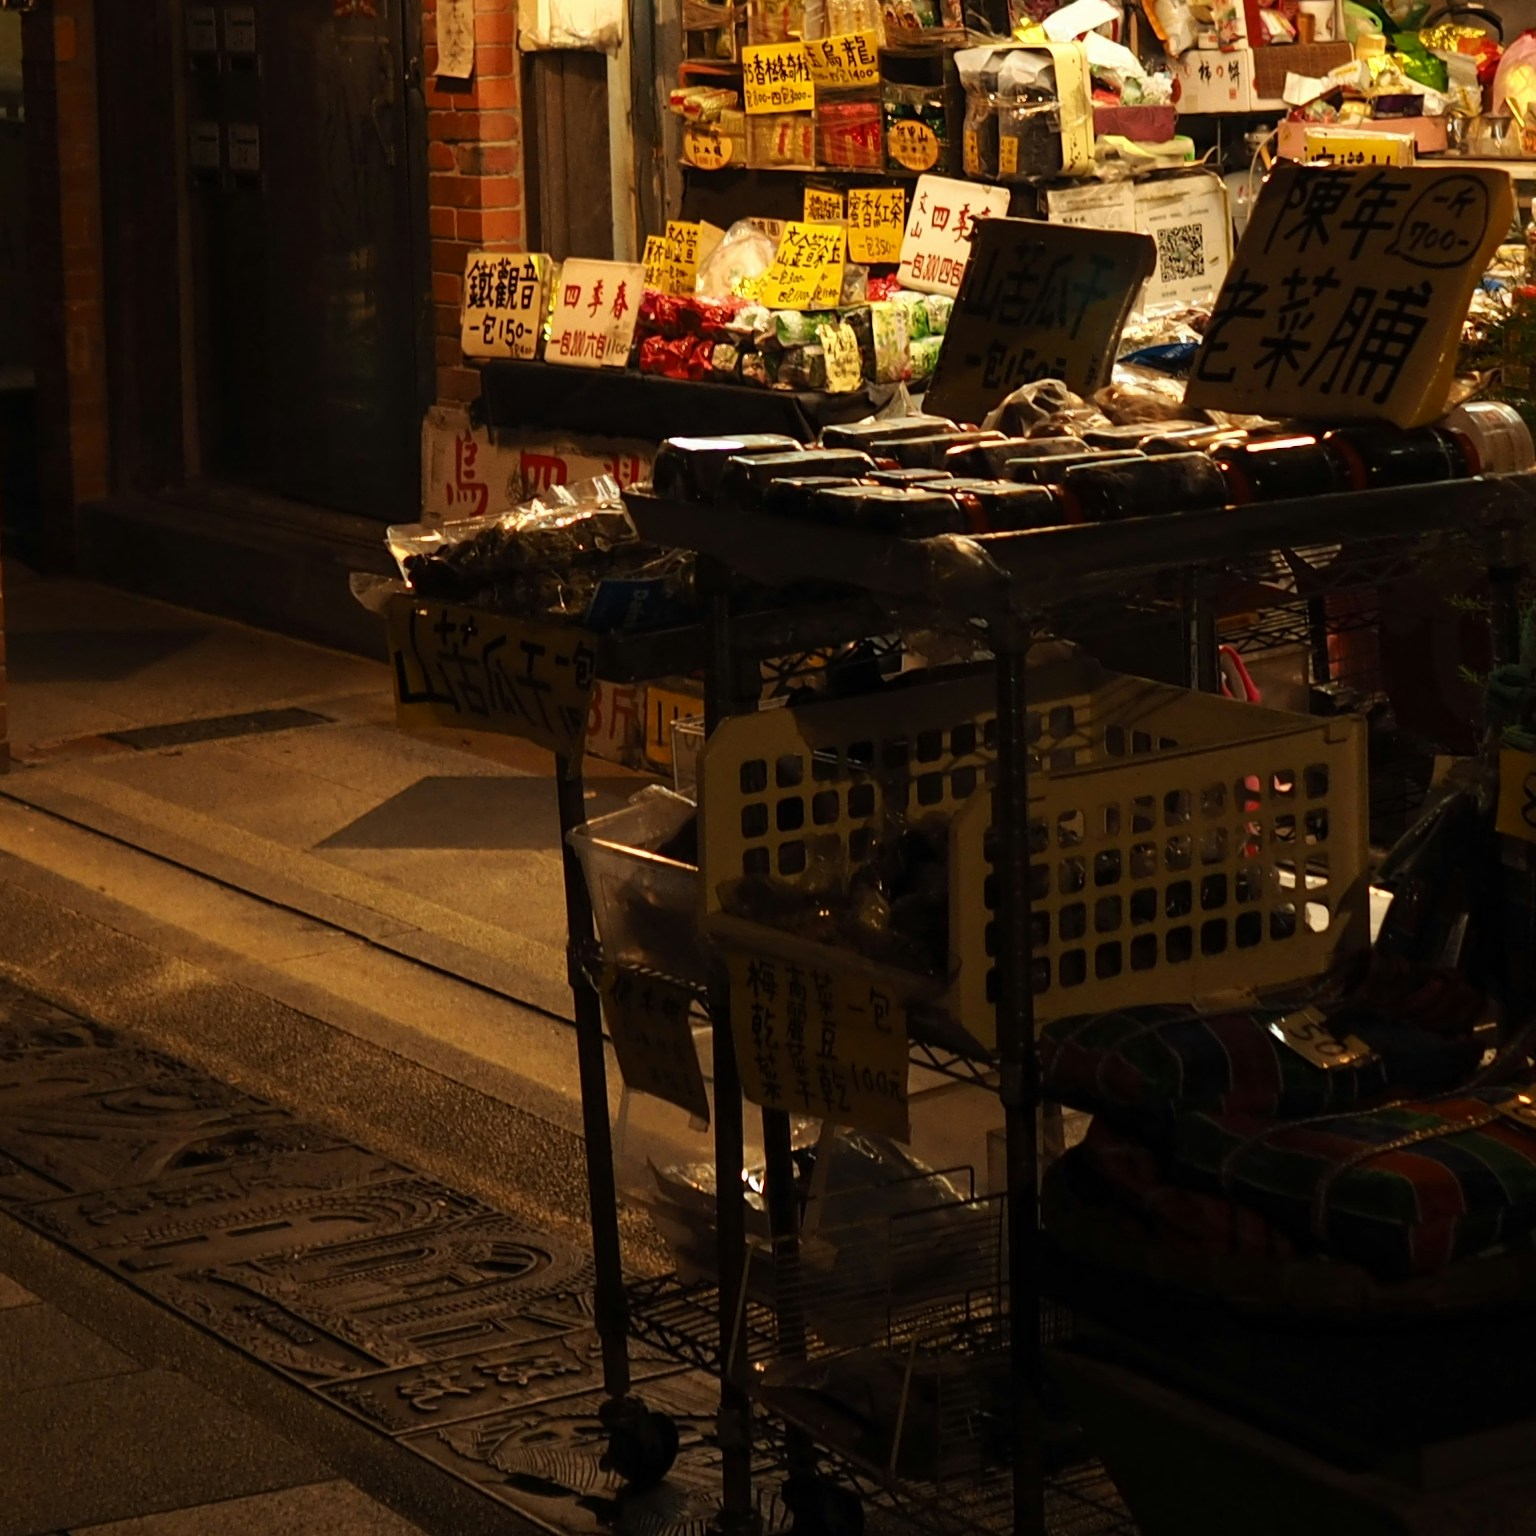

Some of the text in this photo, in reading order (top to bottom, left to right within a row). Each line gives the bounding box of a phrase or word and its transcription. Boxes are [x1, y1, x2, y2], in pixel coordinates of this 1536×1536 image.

[1262, 166, 1413, 262] 陳年
[466, 256, 541, 311] 鐵觀音
[562, 277, 630, 322] 四季春
[1195, 266, 1435, 406] 老菜脯
